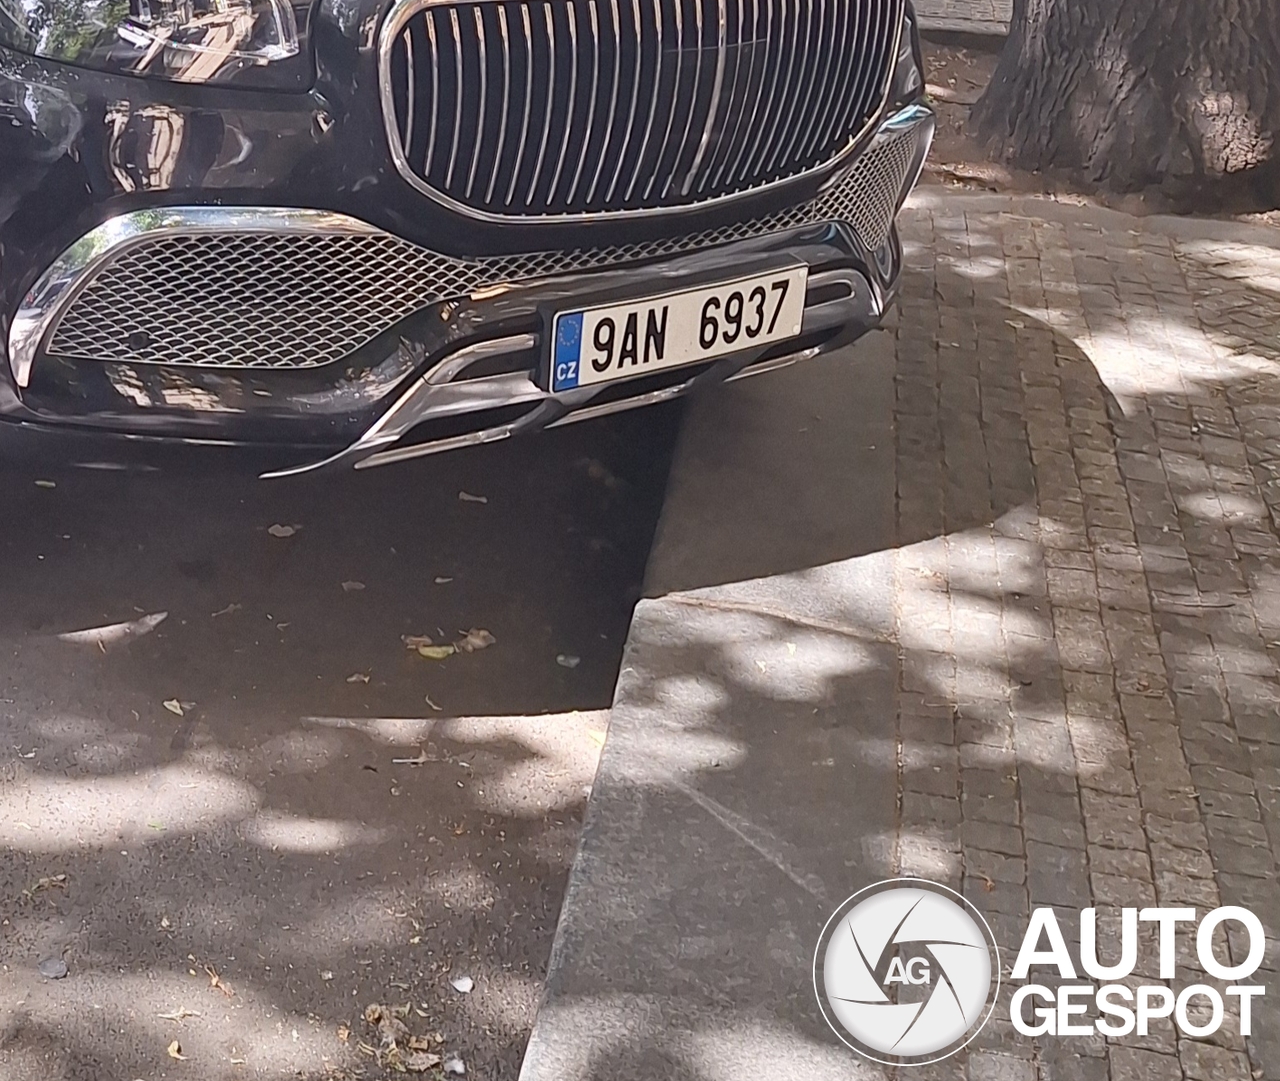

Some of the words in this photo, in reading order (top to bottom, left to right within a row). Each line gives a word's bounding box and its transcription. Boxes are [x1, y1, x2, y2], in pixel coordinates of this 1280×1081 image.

[591, 306, 669, 372] 9AN
[699, 279, 790, 350] 6937
[557, 361, 576, 381] CZ
